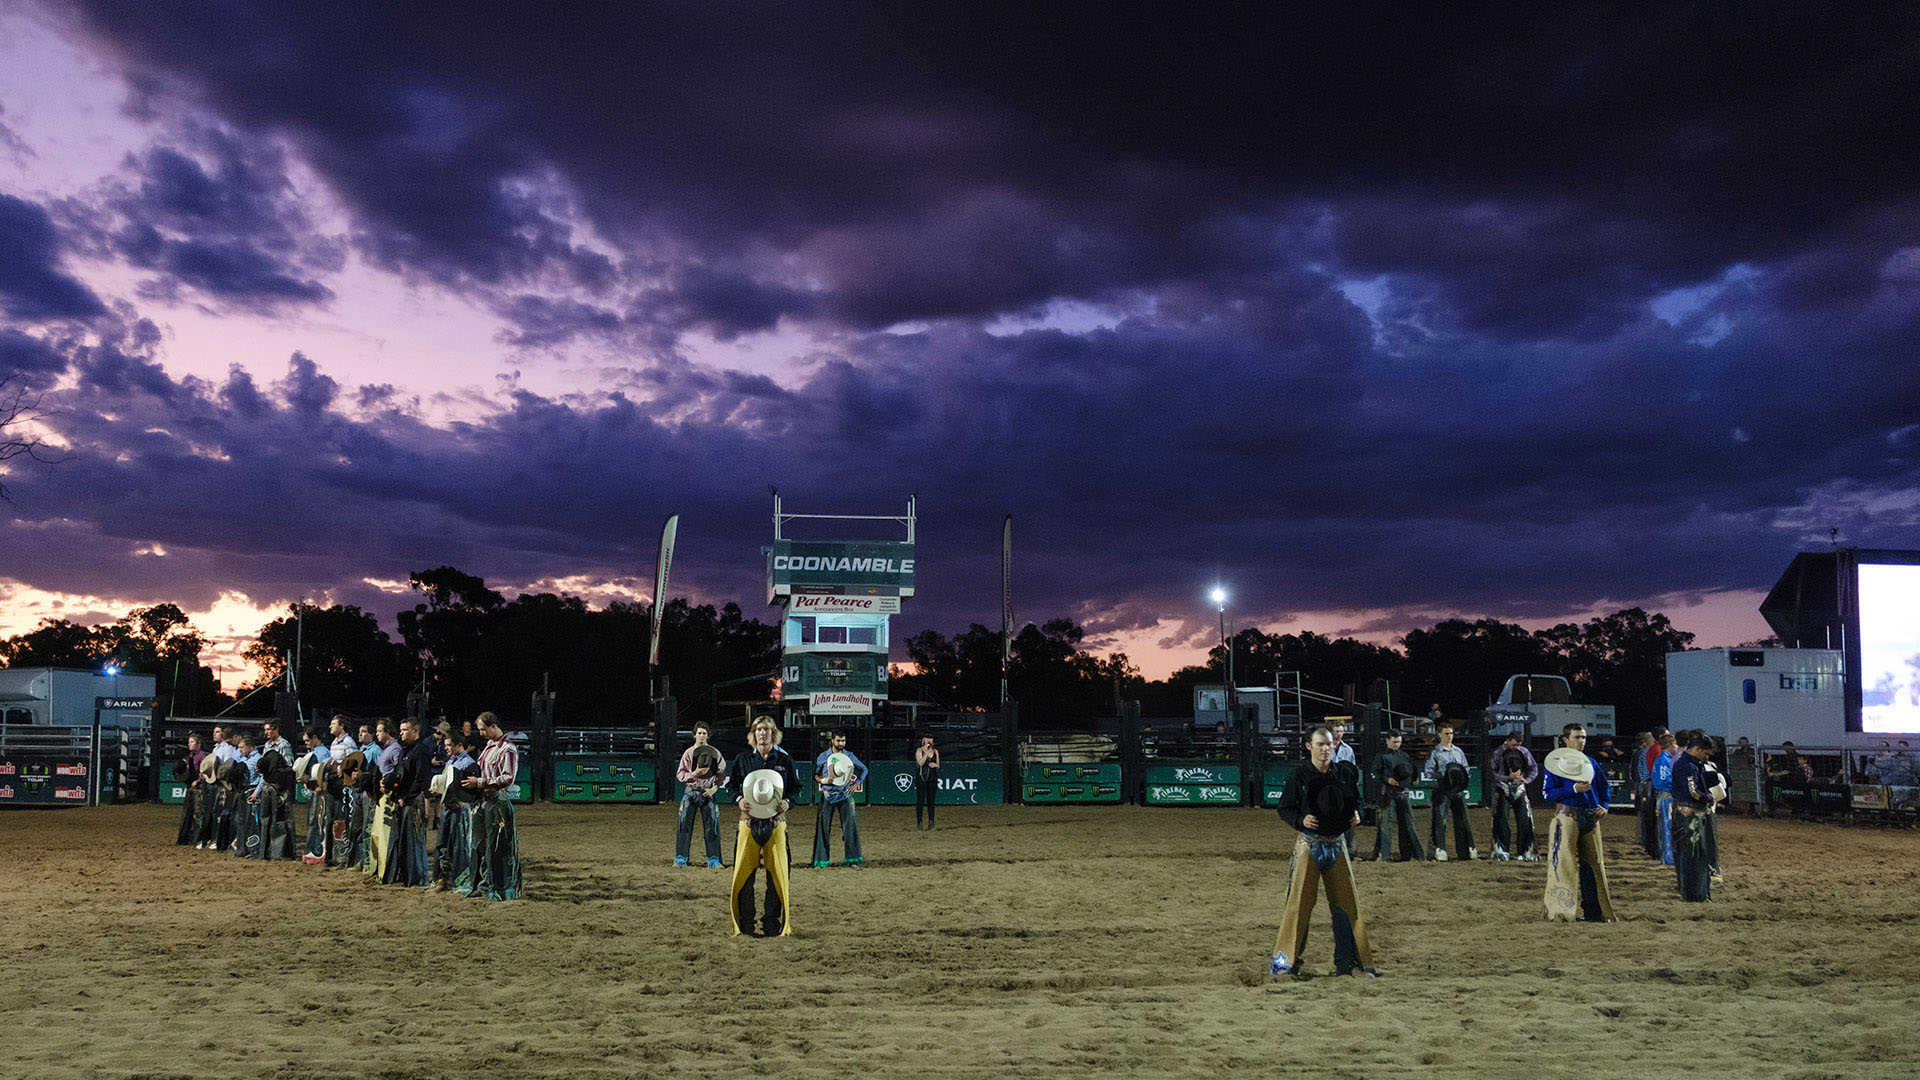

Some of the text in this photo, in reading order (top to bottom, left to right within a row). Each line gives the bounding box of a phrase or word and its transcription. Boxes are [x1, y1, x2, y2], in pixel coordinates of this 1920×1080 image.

[774, 556, 915, 573] COONAMBLE
[796, 596, 821, 608] Pat
[823, 596, 873, 609] Pearce
[113, 700, 144, 708] ARIAT
[812, 693, 871, 708] John Lundholm
[914, 778, 978, 790] RIAT
